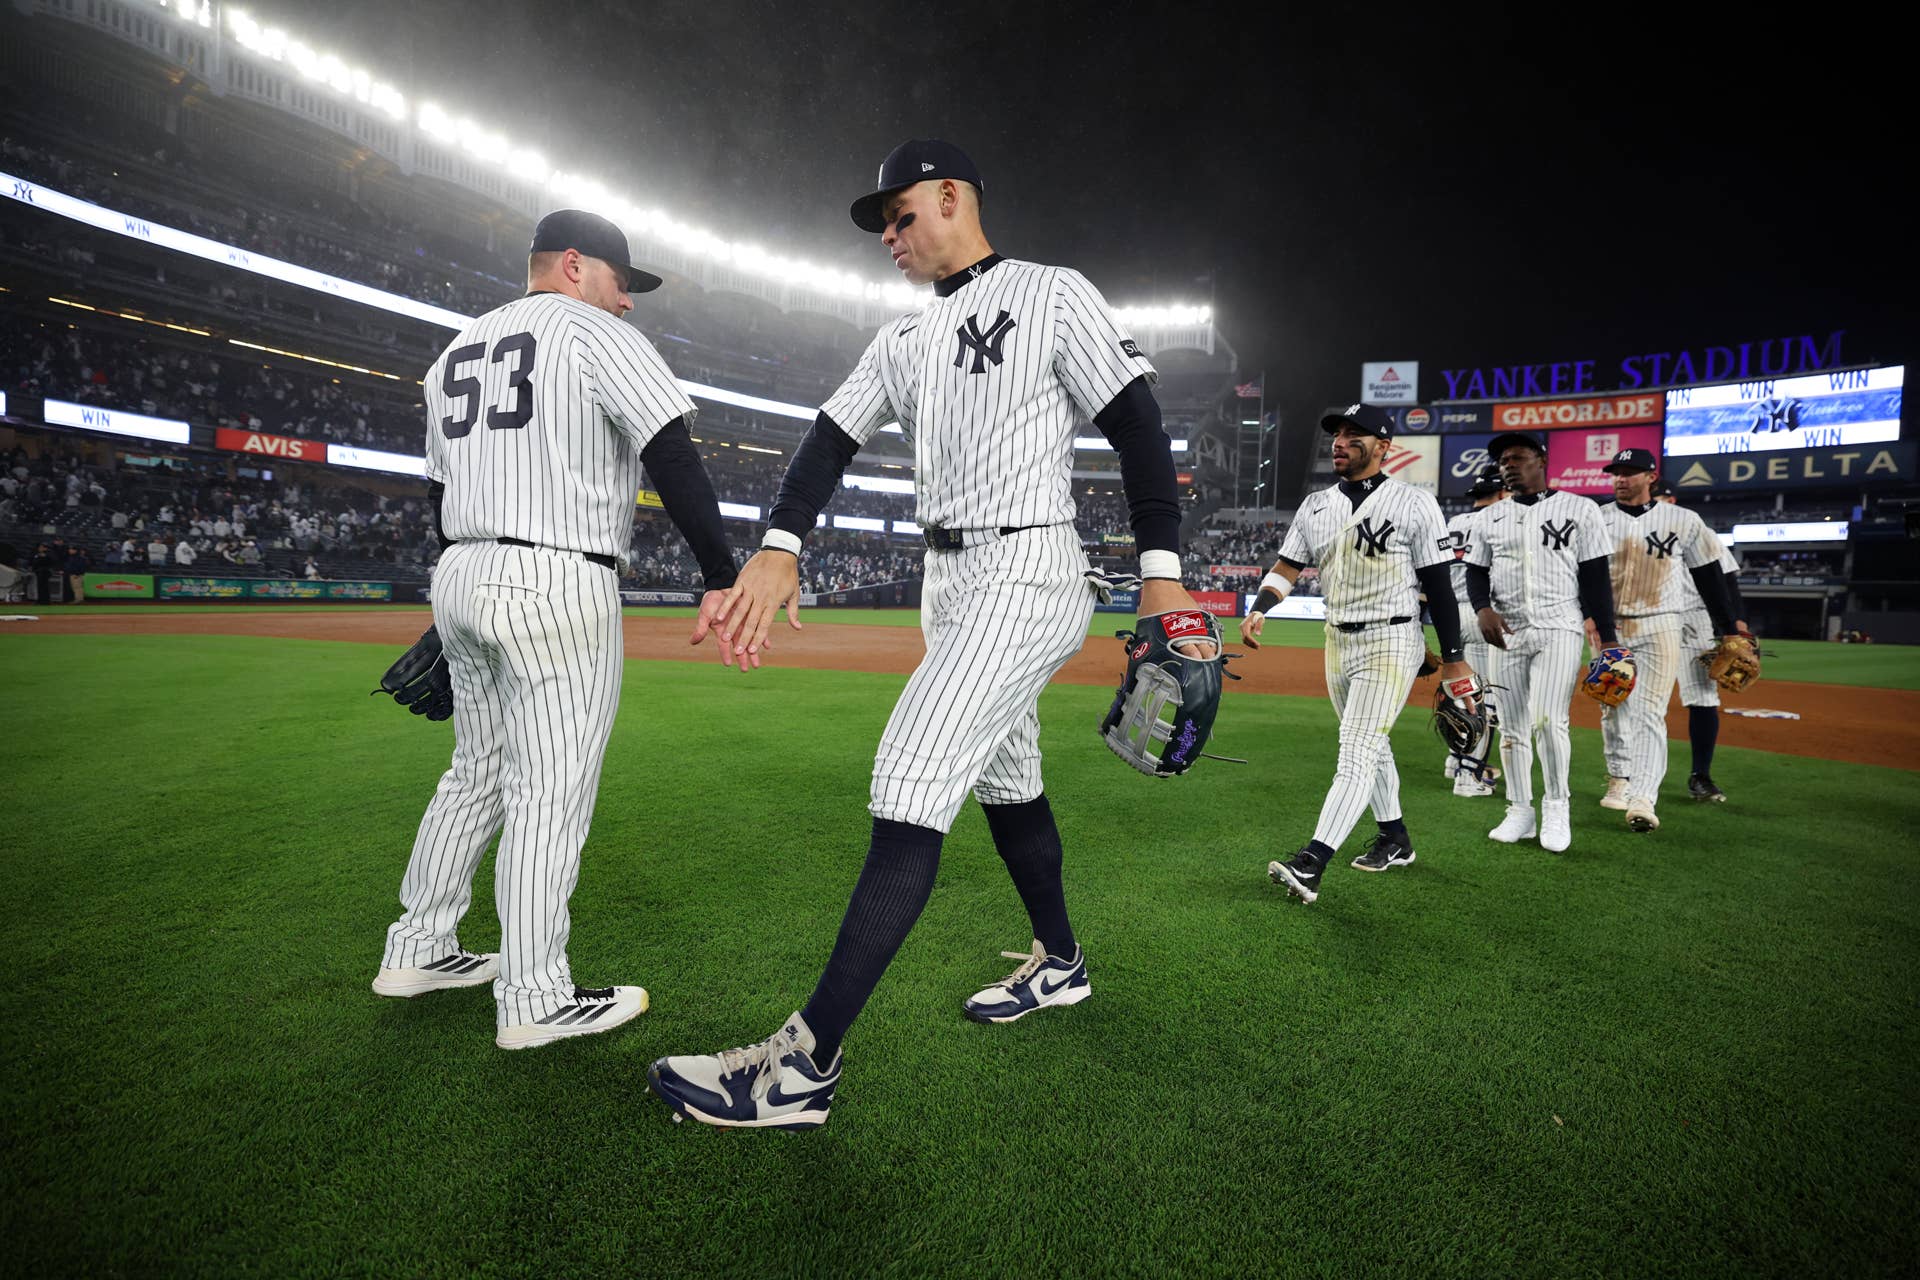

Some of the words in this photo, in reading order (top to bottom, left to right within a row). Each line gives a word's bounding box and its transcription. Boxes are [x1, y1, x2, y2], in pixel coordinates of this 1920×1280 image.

[125, 216, 151, 237] WIN
[953, 310, 1017, 375] NY
[1440, 360, 1596, 401] YANKEE
[1618, 330, 1847, 390] STADIUM
[442, 331, 537, 440] 53
[1368, 382, 1413, 392] Benjamin
[1373, 390, 1405, 399] Moore
[1740, 380, 1775, 401] WIN
[1828, 369, 1870, 391] WIN
[82, 408, 111, 427] WIN
[1442, 413, 1478, 423] PEPSI
[1502, 398, 1656, 427] GATORADE
[243, 434, 304, 458] AVIS
[1717, 434, 1751, 454] WIN
[1803, 427, 1842, 448] WIN
[1728, 450, 1899, 482] DELTA
[1354, 517, 1396, 557] NY
[1540, 519, 1576, 551] NY
[1645, 531, 1680, 559] NY
